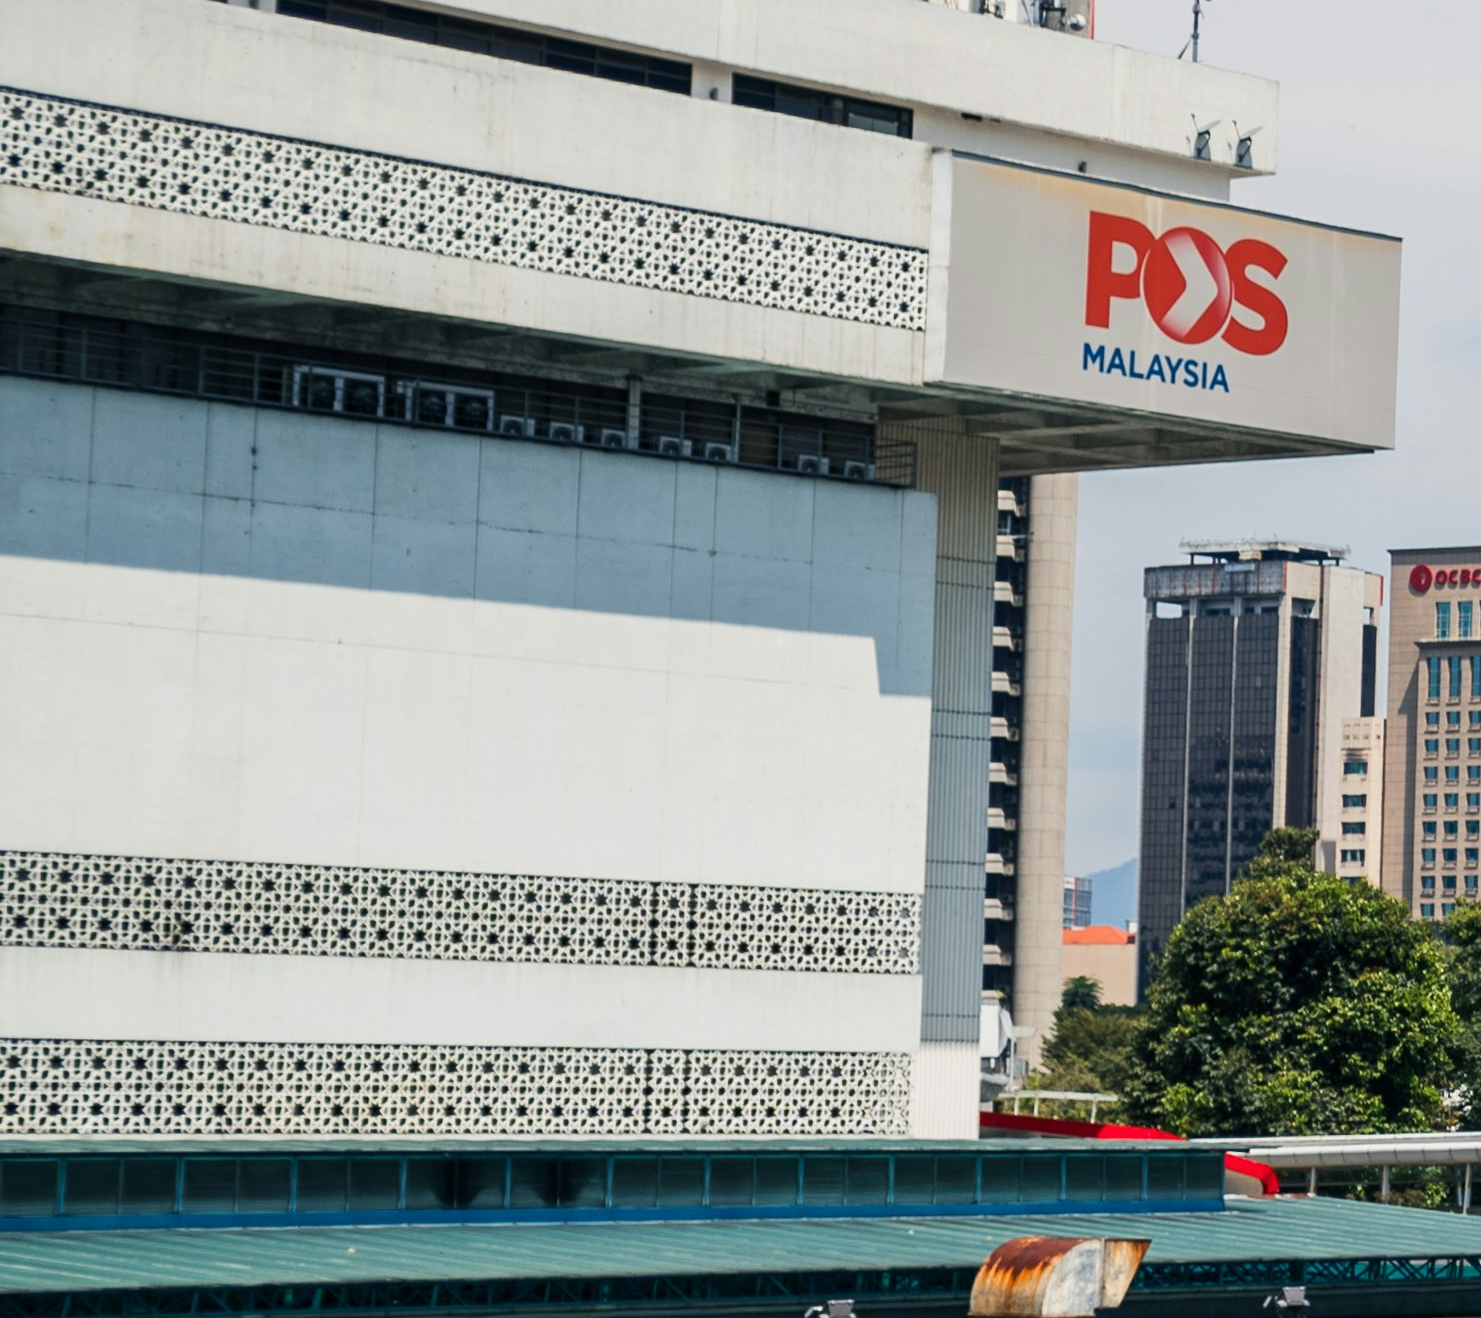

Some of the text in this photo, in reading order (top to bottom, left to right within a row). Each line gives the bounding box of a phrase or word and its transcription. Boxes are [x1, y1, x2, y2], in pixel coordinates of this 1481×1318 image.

[1085, 210, 1288, 355] POS
[1082, 342, 1229, 393] MALAYSIA
[1435, 569, 1481, 585] OCBC
